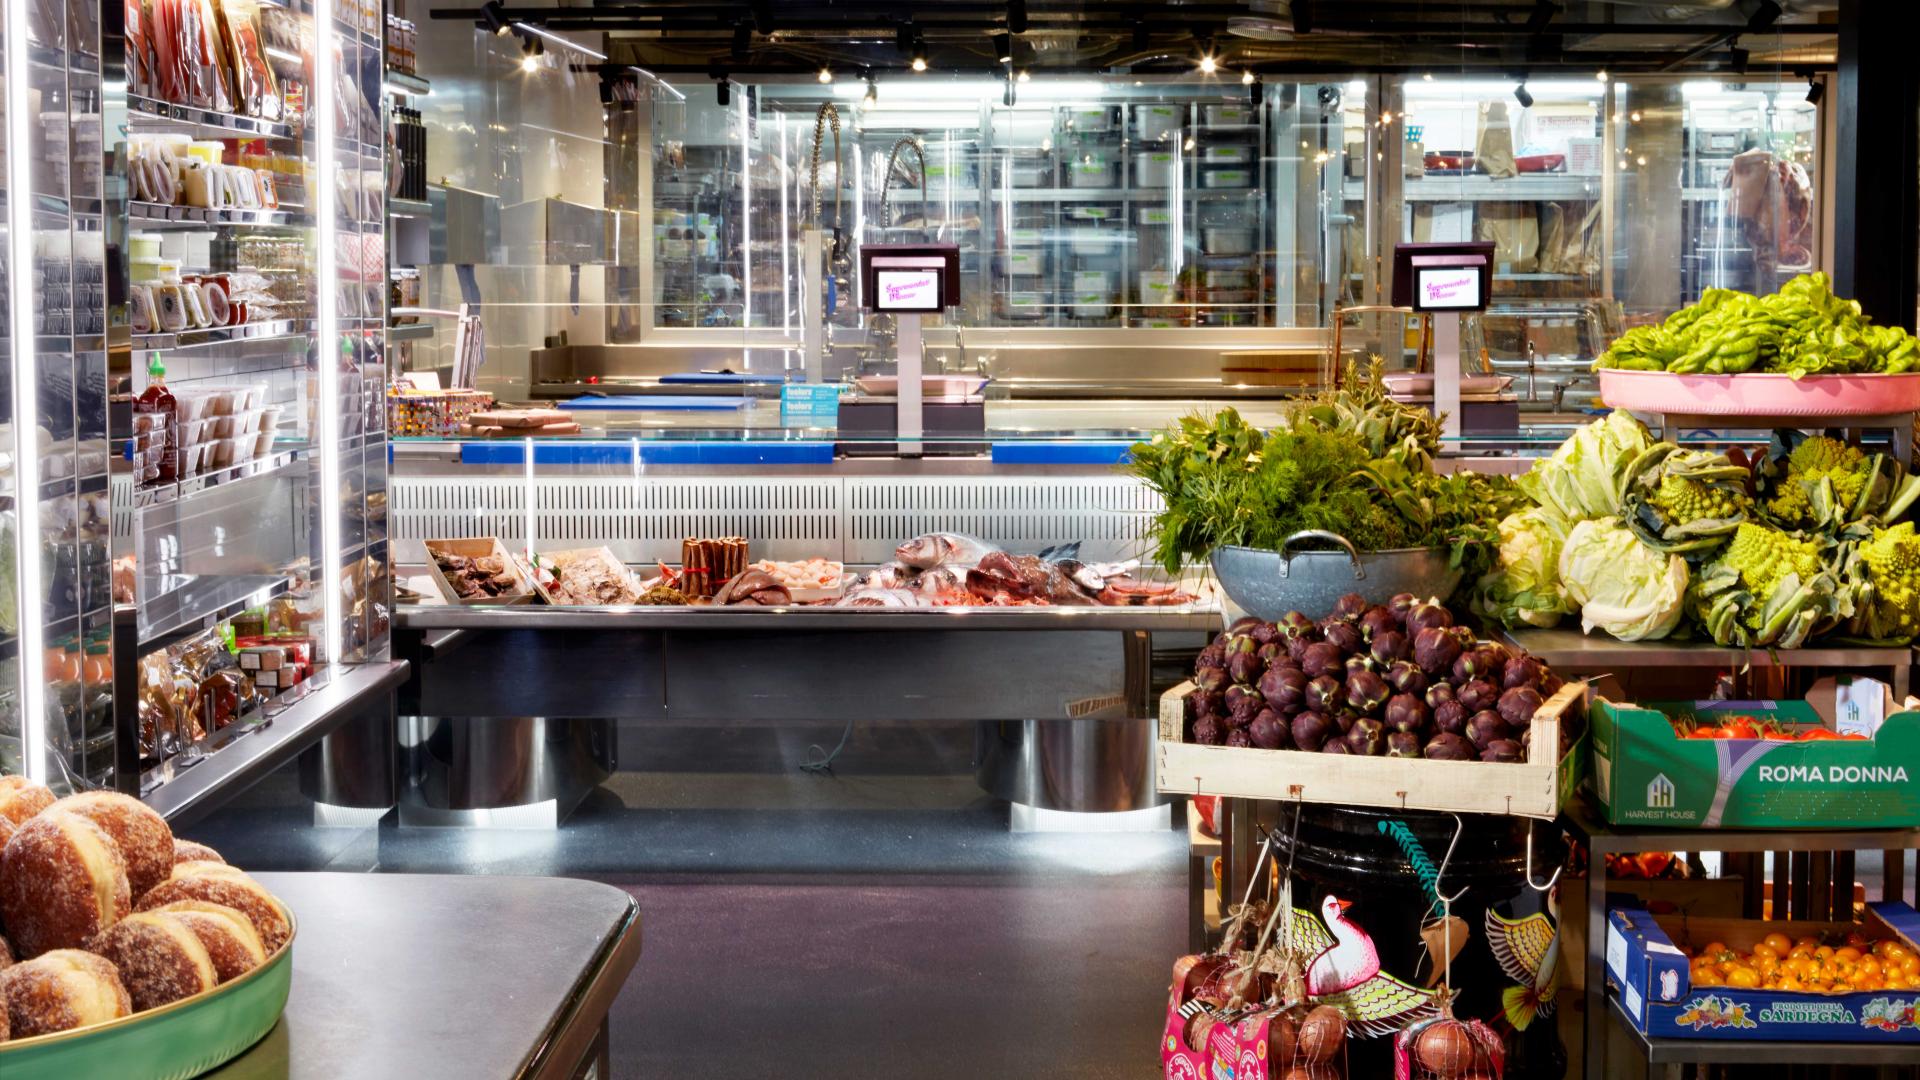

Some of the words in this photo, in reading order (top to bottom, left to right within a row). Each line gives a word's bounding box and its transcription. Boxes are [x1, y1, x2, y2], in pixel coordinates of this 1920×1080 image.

[1759, 765, 1825, 783] ROMA
[1829, 765, 1909, 783] DONNA
[1625, 810, 1665, 819] HARVEST
[1666, 810, 1696, 820] HOUSE
[1772, 1002, 1815, 1010] PRODOTTI
[1816, 1002, 1844, 1011] DELLA
[1759, 1009, 1856, 1023] SARDEGNA
